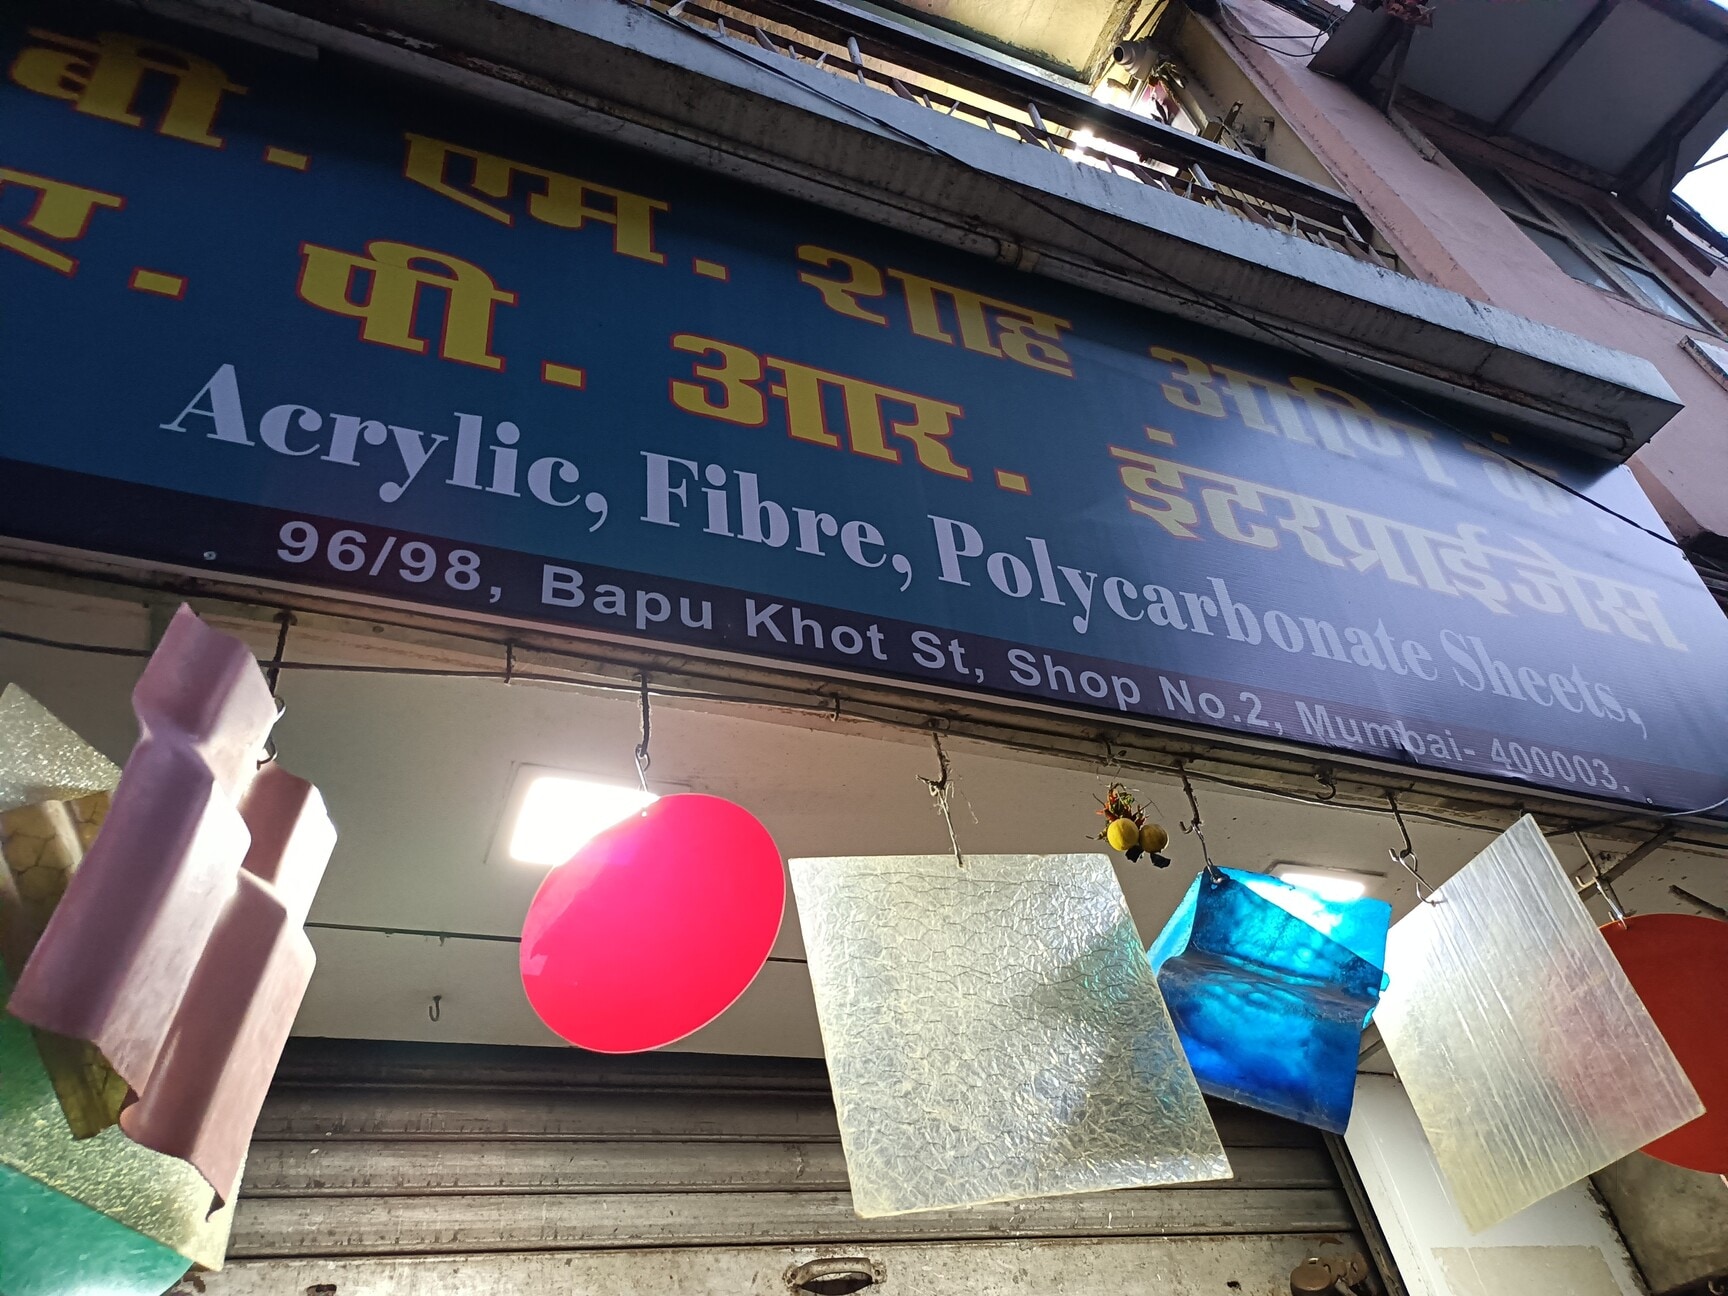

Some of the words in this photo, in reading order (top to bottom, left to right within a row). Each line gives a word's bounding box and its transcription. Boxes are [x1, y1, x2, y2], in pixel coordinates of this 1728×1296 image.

[297, 239, 586, 389] पी.
[669, 332, 1031, 495] आर.
[1108, 425, 1690, 653] इंटरप्राईजेस
[403, 131, 728, 281] एम.
[796, 243, 1075, 379] शाह
[1149, 345, 1456, 487] आणि
[159, 363, 609, 532] Acrylic,
[640, 450, 912, 592] Fibre,
[926, 514, 1438, 682] Polycarbonate
[1438, 628, 1648, 740] Sheets,
[277, 520, 502, 603] 96/98,
[541, 564, 713, 630] Bapu
[745, 597, 888, 661] Khot
[911, 630, 985, 684] St,
[1007, 647, 1141, 712] Shop
[1158, 675, 1284, 736] No.2,
[1298, 701, 1478, 764] Mumbai-
[1490, 737, 1632, 794] 400003.
